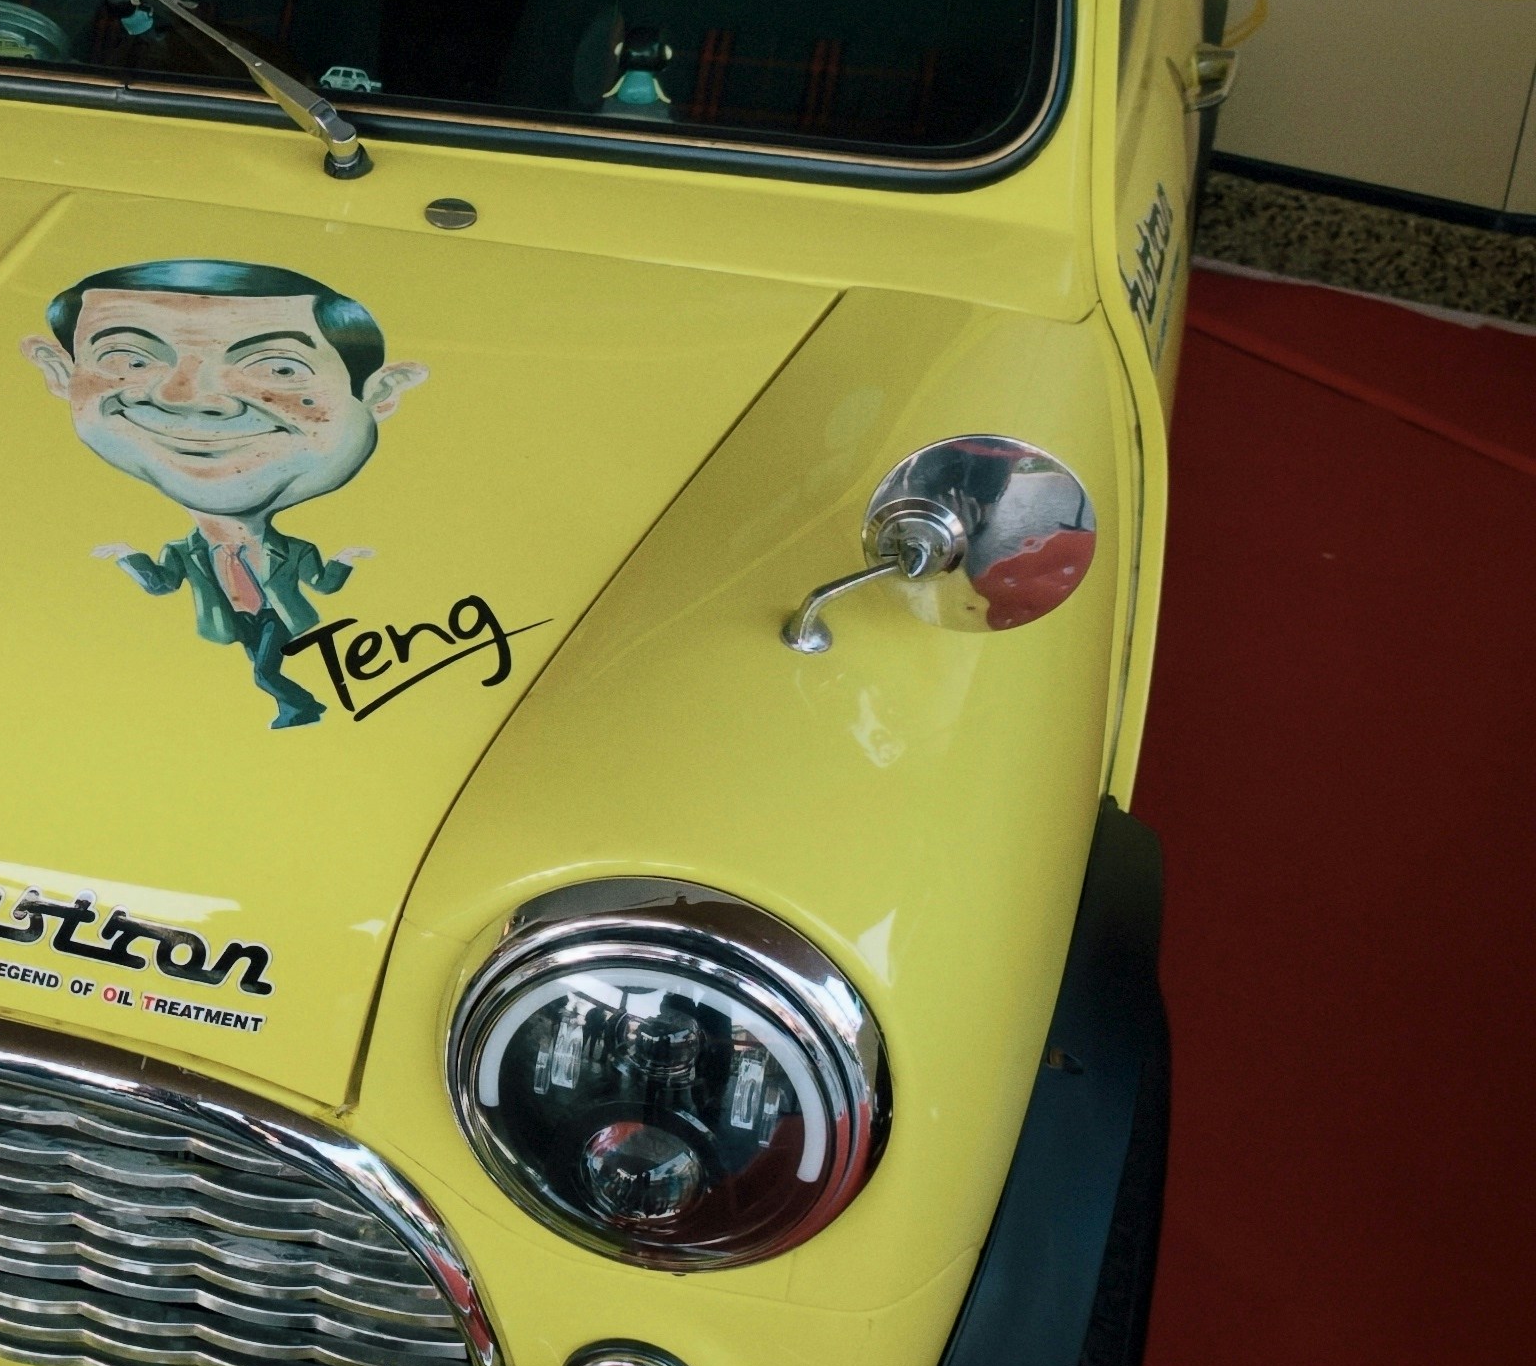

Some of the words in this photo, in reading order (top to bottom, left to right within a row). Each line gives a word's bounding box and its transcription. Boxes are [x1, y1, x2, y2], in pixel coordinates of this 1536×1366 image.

[280, 595, 555, 722] Teng
[70, 978, 95, 997] OF
[103, 986, 134, 1008] OIL
[143, 994, 264, 1033] TREATMENT
